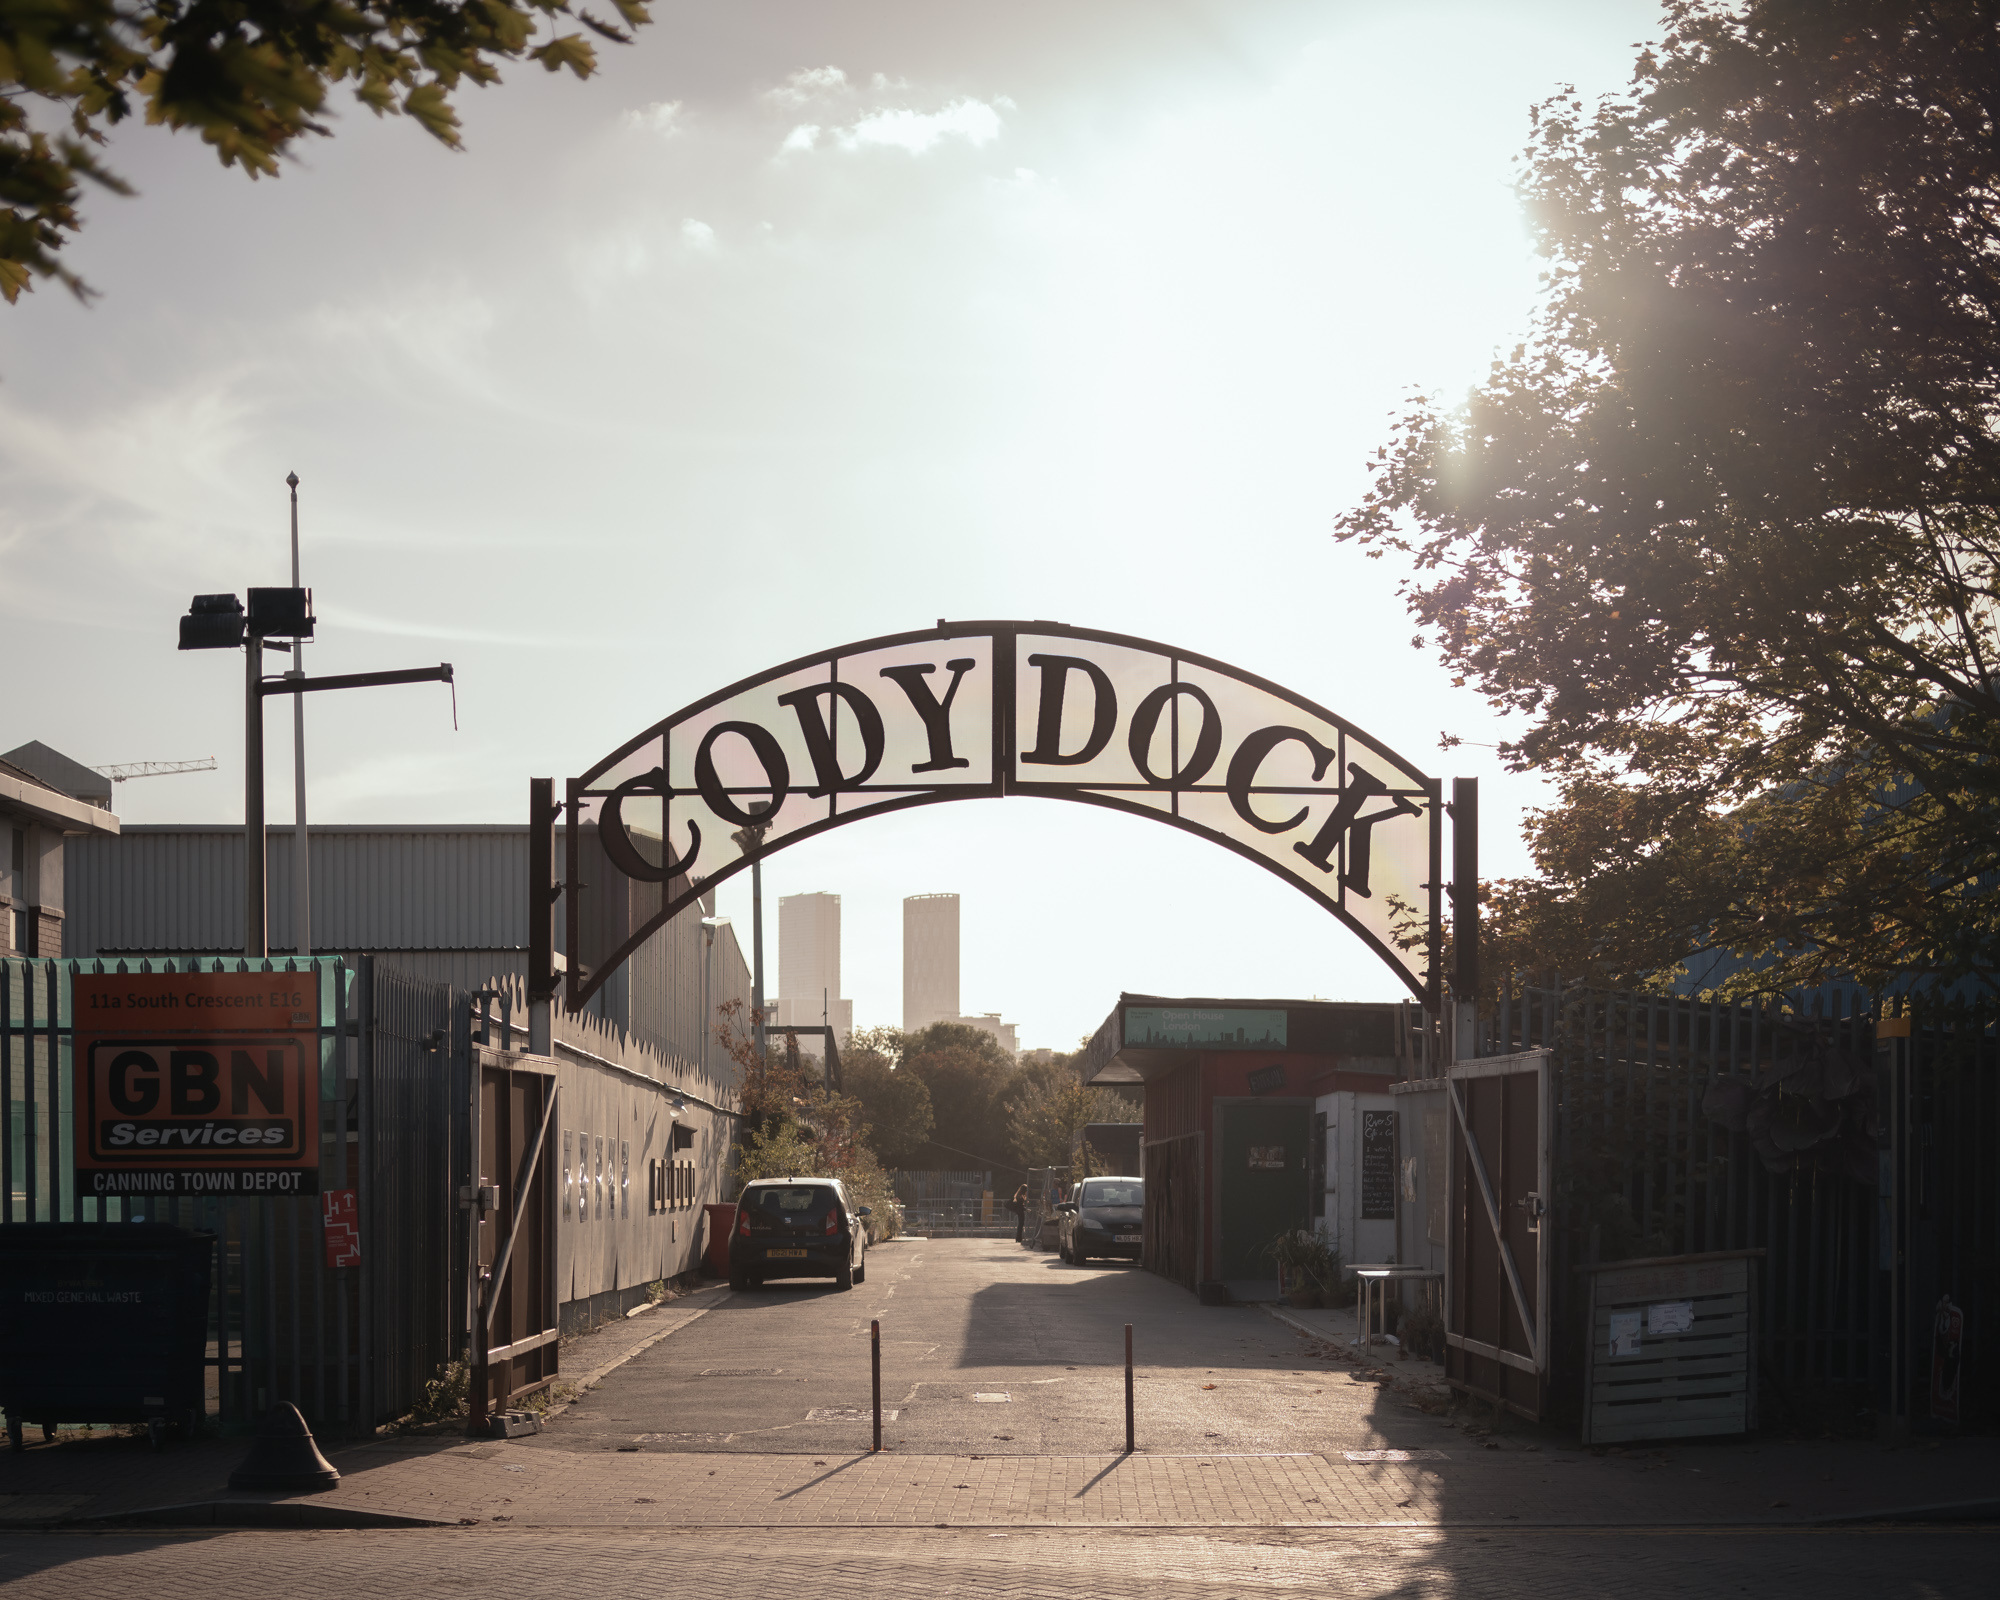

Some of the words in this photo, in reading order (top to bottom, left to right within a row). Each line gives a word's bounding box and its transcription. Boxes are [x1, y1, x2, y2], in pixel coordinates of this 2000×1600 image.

[599, 658, 976, 882] CODY
[1020, 653, 1423, 897] DOCK
[90, 993, 121, 1008] 11a
[127, 992, 179, 1008] South
[185, 992, 264, 1008] Crescent
[270, 992, 302, 1007] E16
[1162, 1011, 1190, 1021] Open
[1193, 1011, 1225, 1020] House
[1163, 1021, 1201, 1031] London
[108, 1050, 284, 1115] GBN
[109, 1123, 285, 1145] Services
[93, 1173, 174, 1191] CANNING
[181, 1172, 235, 1190] TOWN
[242, 1172, 302, 1190] DEPOT
[24, 1291, 55, 1303] MIXED
[56, 1291, 105, 1303] GENERAL
[106, 1291, 142, 1302] WASTE
